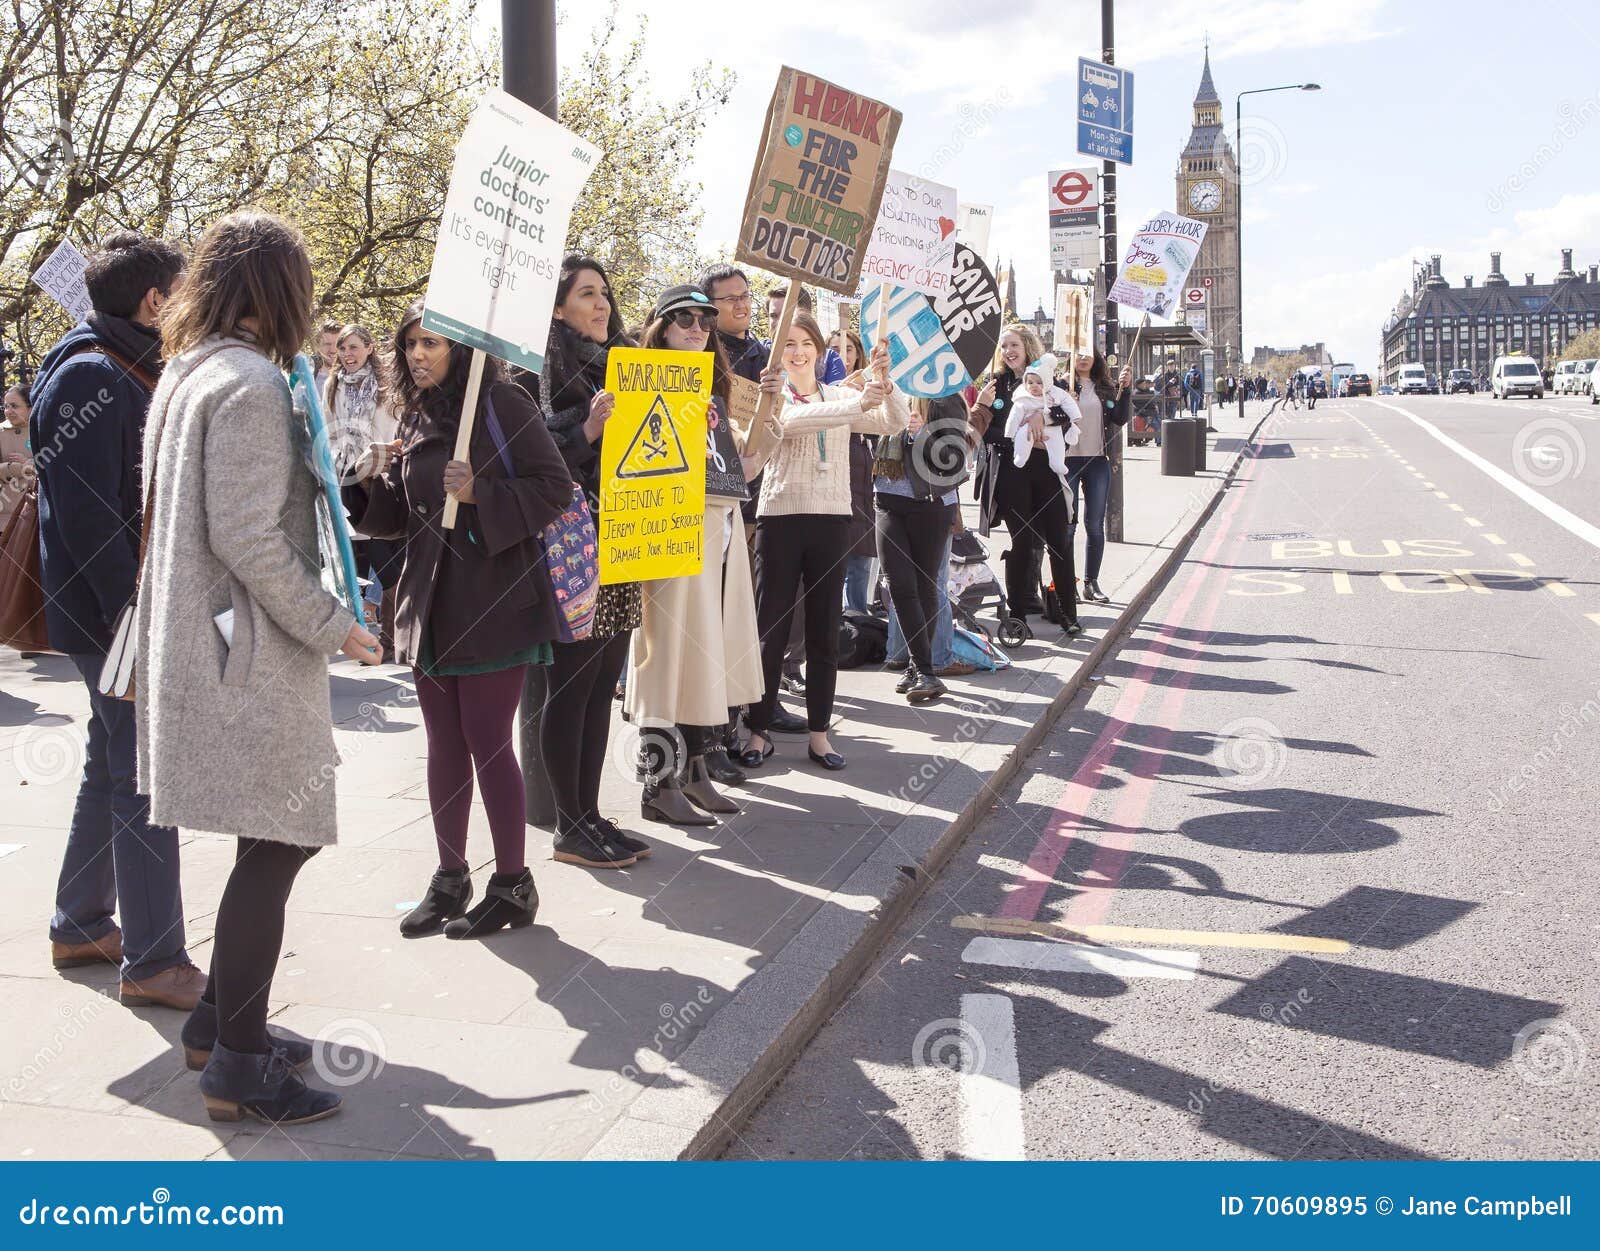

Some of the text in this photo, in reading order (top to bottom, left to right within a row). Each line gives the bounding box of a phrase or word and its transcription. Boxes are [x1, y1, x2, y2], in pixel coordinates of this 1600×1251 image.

[792, 76, 889, 145] HONK
[1082, 108, 1096, 118] taxi
[492, 145, 550, 186] Junior
[571, 146, 592, 165] BMA
[803, 128, 858, 174] FOR
[1095, 144, 1109, 156] any
[1110, 146, 1125, 158] time
[798, 159, 850, 205] THE
[884, 183, 942, 210] OU TO OUR
[473, 195, 546, 244] contract
[761, 179, 864, 250] JUNIOR
[879, 201, 940, 234] NSULTANTS
[970, 207, 987, 216] BMA
[1175, 220, 1203, 238] HOUR
[449, 212, 555, 281] It's everyone's
[751, 216, 855, 283] DOCTORS
[49, 256, 85, 295] DOCTOR
[60, 272, 85, 308] CONTRA
[481, 257, 518, 292] fight
[861, 254, 948, 293] ERGENCY COVER
[952, 249, 1001, 325] SAVE
[934, 284, 975, 343] UR
[616, 362, 702, 393] WARNING
[603, 487, 664, 513] LISTENING
[671, 486, 685, 505] TO
[602, 518, 635, 540] JEREMY
[640, 516, 668, 536] COULD
[610, 546, 641, 565] DAMAGE
[1270, 539, 1475, 560] BUS
[1227, 568, 1577, 597] STOP
